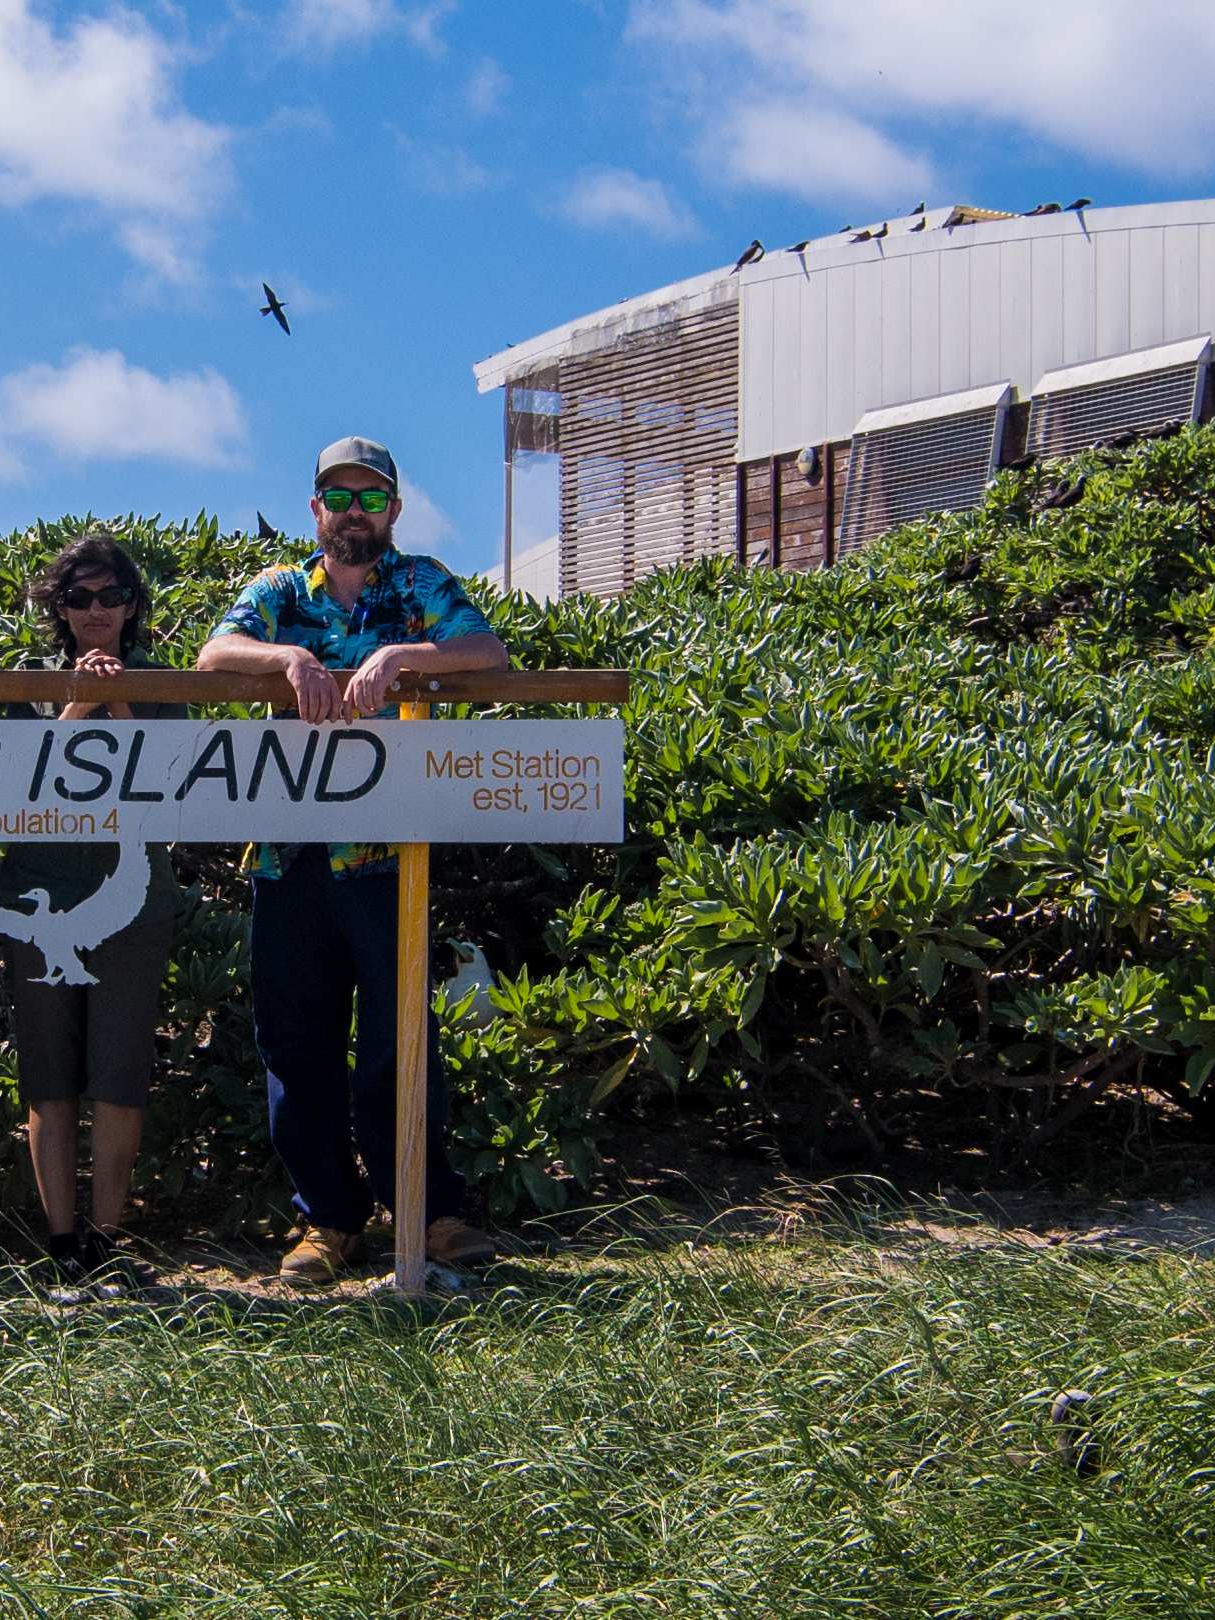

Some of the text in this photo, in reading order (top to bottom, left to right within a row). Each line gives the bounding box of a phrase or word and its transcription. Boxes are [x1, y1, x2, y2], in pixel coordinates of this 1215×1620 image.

[28, 729, 387, 802] ISLAND
[426, 749, 600, 779] Met Station
[473, 783, 602, 813] est, 1921
[101, 808, 121, 834] 4
